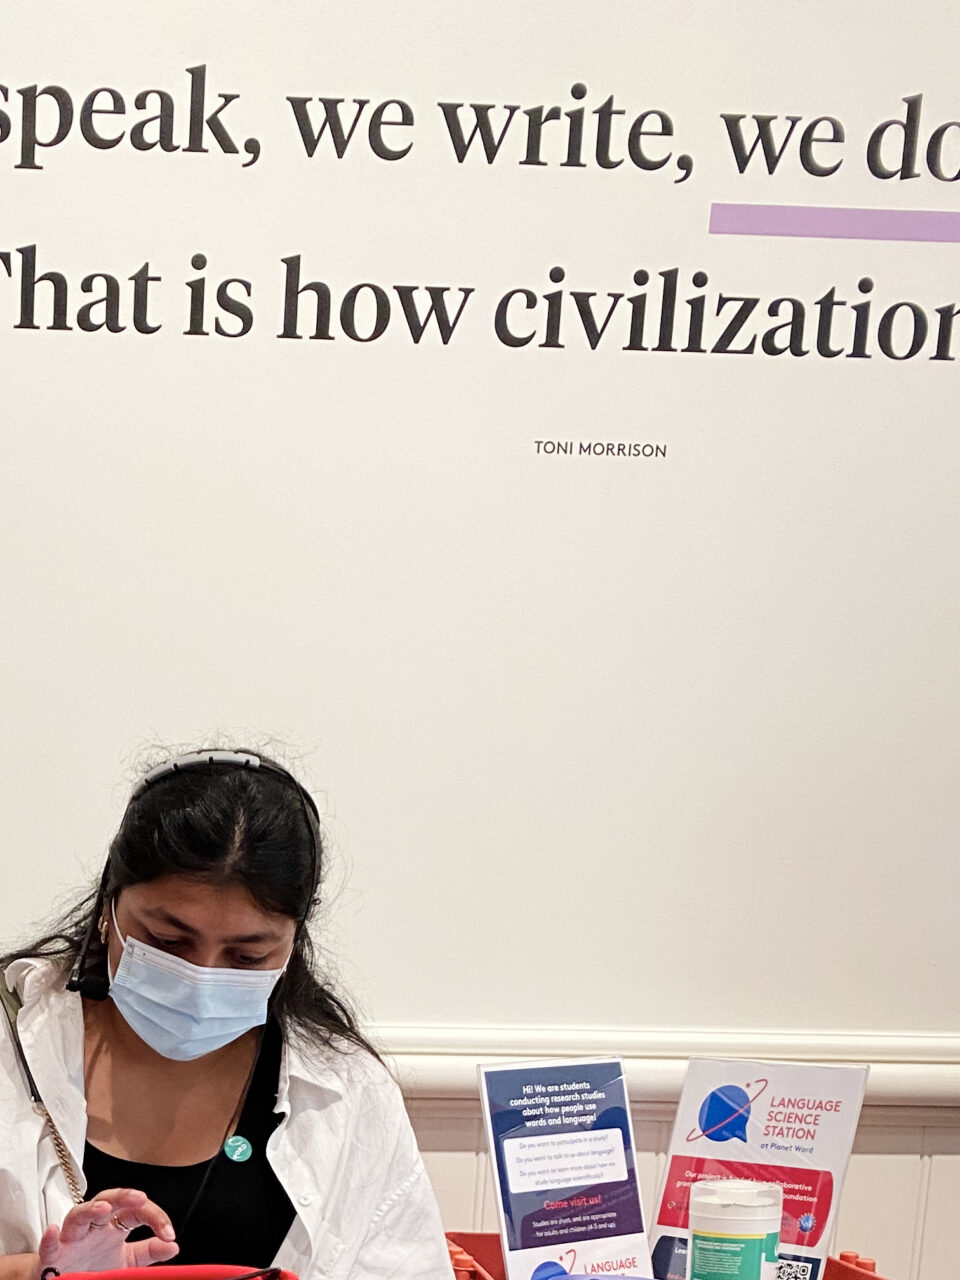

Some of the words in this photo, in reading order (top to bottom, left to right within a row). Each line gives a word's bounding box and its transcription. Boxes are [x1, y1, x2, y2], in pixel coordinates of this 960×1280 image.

[286, 96, 414, 161] we
[437, 82, 693, 184] write,
[720, 114, 845, 178] we
[866, 93, 960, 182] do
[183, 253, 254, 338] is
[276, 254, 475, 345] how
[533, 440, 573, 455] TONI
[579, 442, 668, 458] MORRISON
[522, 1085, 534, 1094] Hi!
[534, 1084, 546, 1093] We
[547, 1084, 559, 1092] are
[560, 1081, 591, 1092] students
[509, 1096, 550, 1106] conducting
[551, 1092, 580, 1102] research
[581, 1090, 606, 1100] studies
[770, 1096, 842, 1112] LANGUAGE
[522, 1106, 544, 1116] about
[544, 1105, 560, 1114] how
[561, 1103, 584, 1114] people
[525, 1118, 547, 1128] words
[547, 1116, 562, 1126] and
[562, 1113, 597, 1126] language!
[766, 1110, 821, 1126] SCIENCE
[763, 1125, 816, 1141] STATION
[770, 1142, 793, 1152] Planet
[794, 1145, 814, 1154] Word
[685, 1170, 698, 1178] Our
[543, 1199, 568, 1210] Come
[570, 1195, 586, 1206] visit
[588, 1194, 602, 1205] us!
[584, 1257, 638, 1275] LANGUAGE
